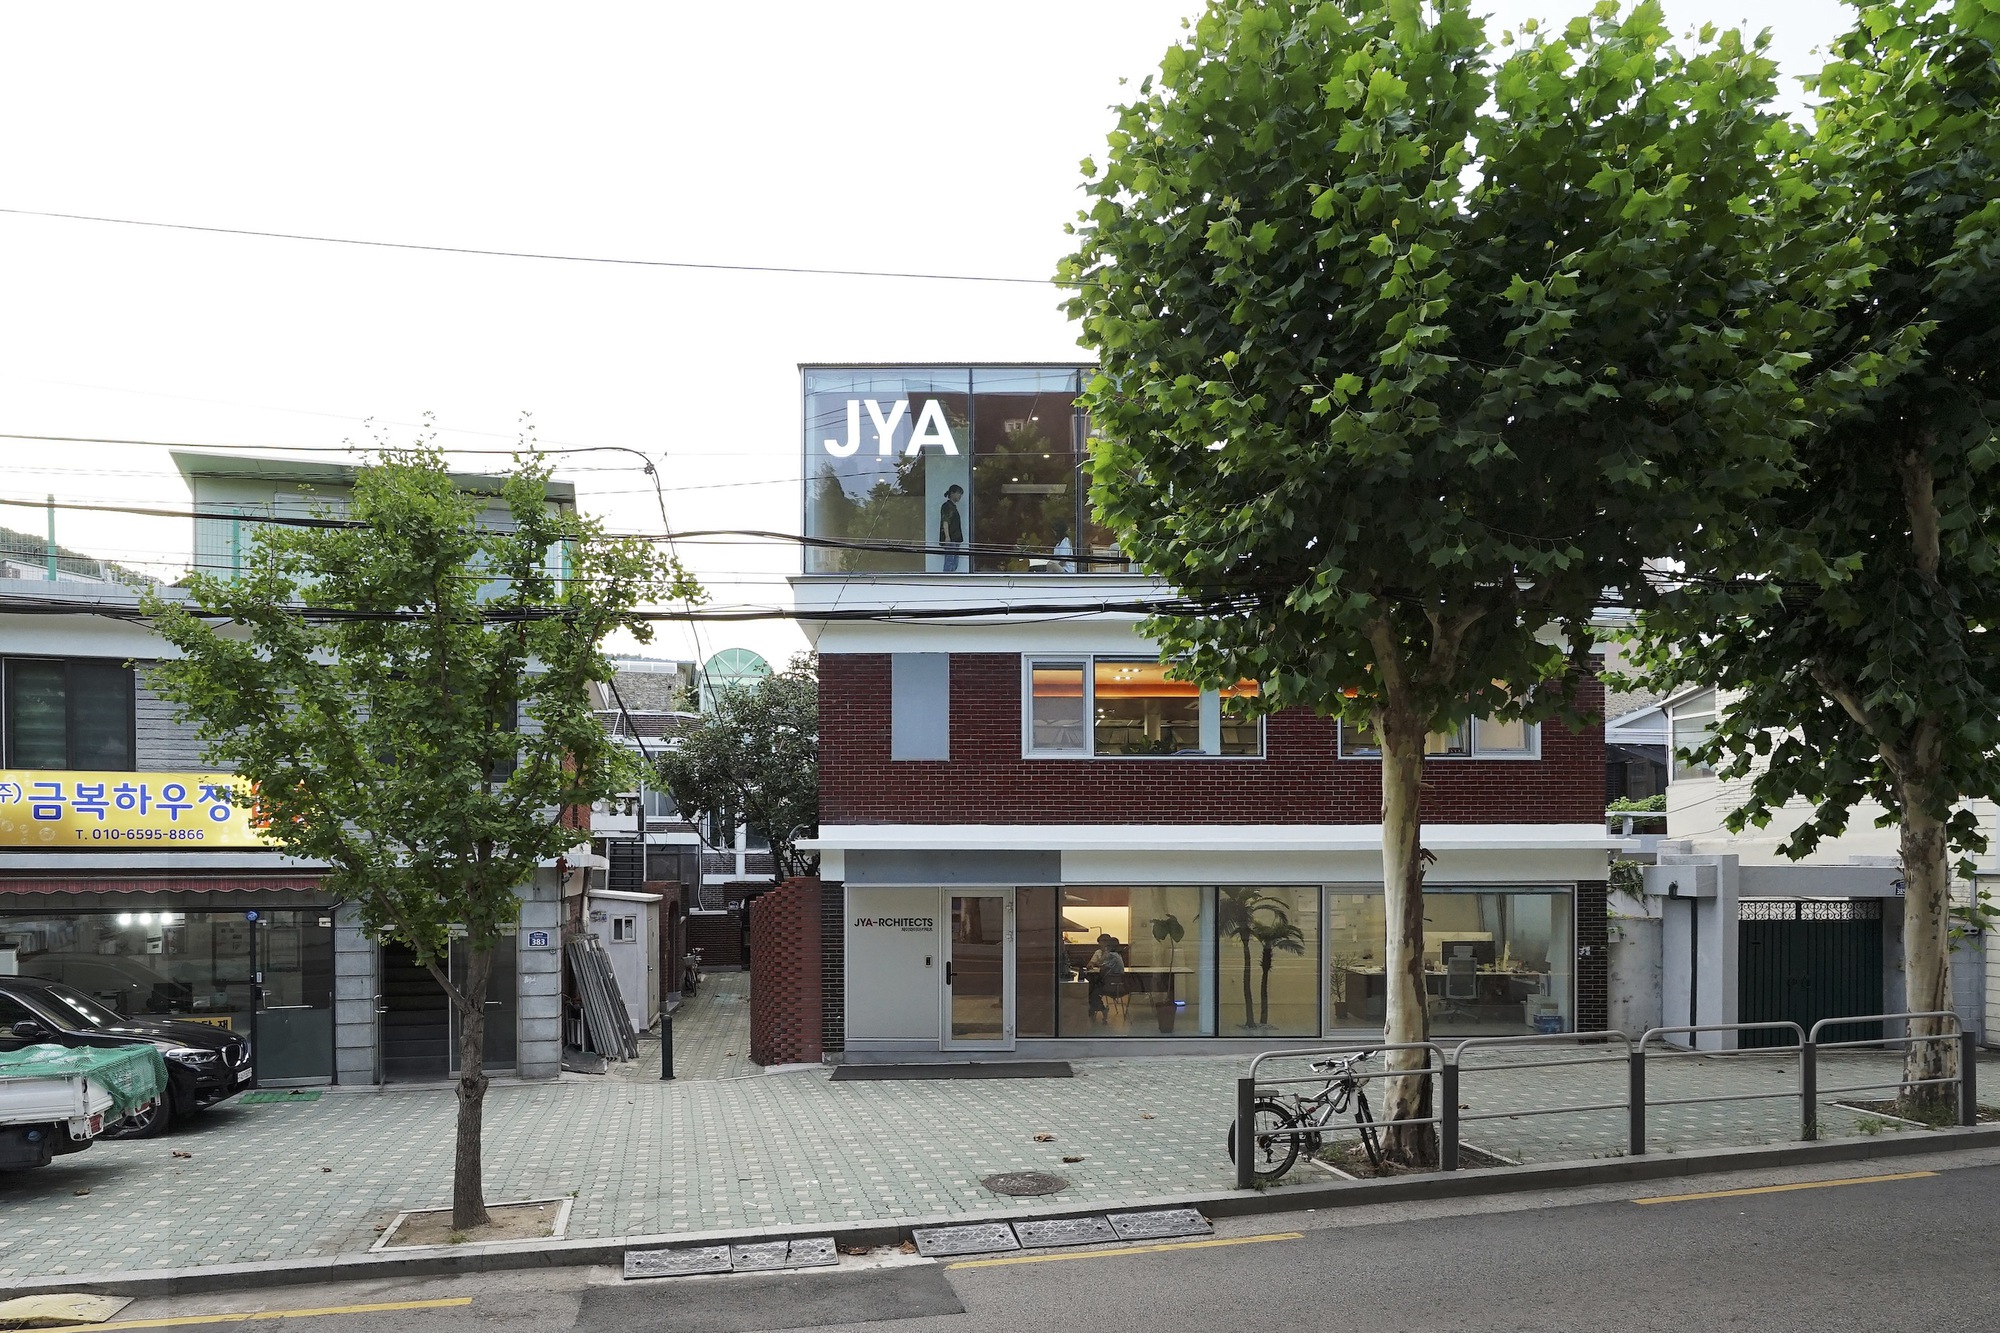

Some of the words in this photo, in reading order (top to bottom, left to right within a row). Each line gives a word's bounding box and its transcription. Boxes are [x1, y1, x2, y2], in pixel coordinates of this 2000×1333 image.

[824, 399, 959, 457] JYA
[75, 829, 88, 840] T.
[92, 829, 204, 840] 010-6595-8866
[854, 918, 933, 927] JYA-RCHITECTS
[531, 938, 546, 946] 383
